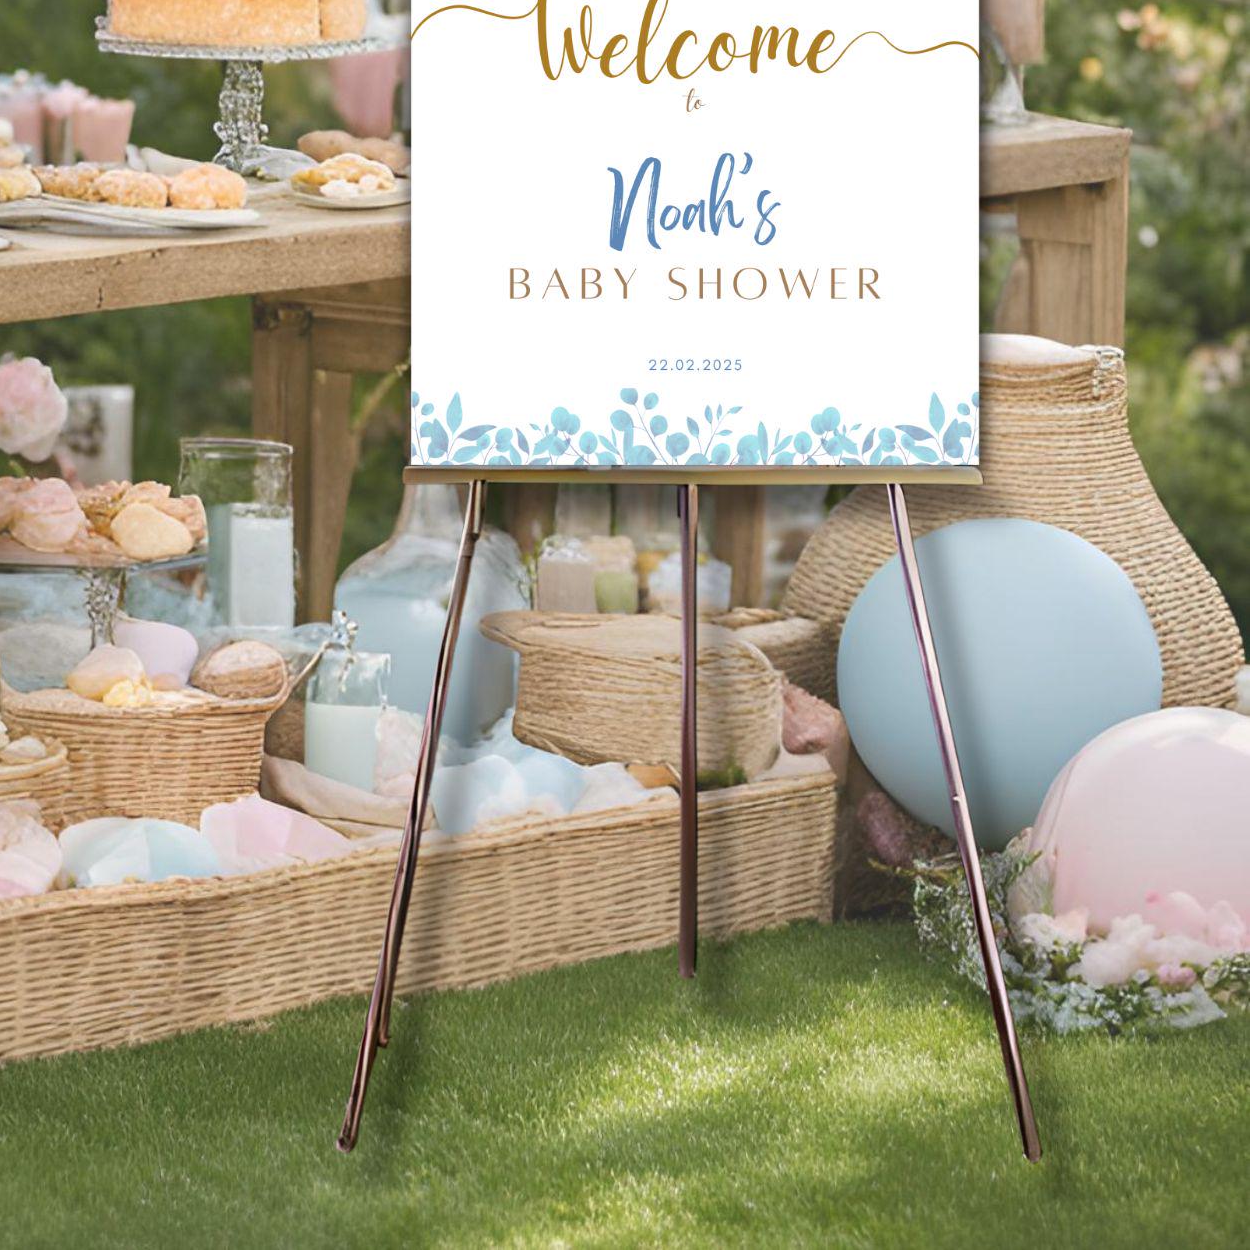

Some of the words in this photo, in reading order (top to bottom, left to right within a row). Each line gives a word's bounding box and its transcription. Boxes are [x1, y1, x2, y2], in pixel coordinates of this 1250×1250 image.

[682, 87, 705, 113] to
[607, 151, 782, 253] Noah's
[509, 267, 637, 300] BABY
[667, 266, 882, 301] SHOWER
[648, 358, 743, 371] 22.02.2025
